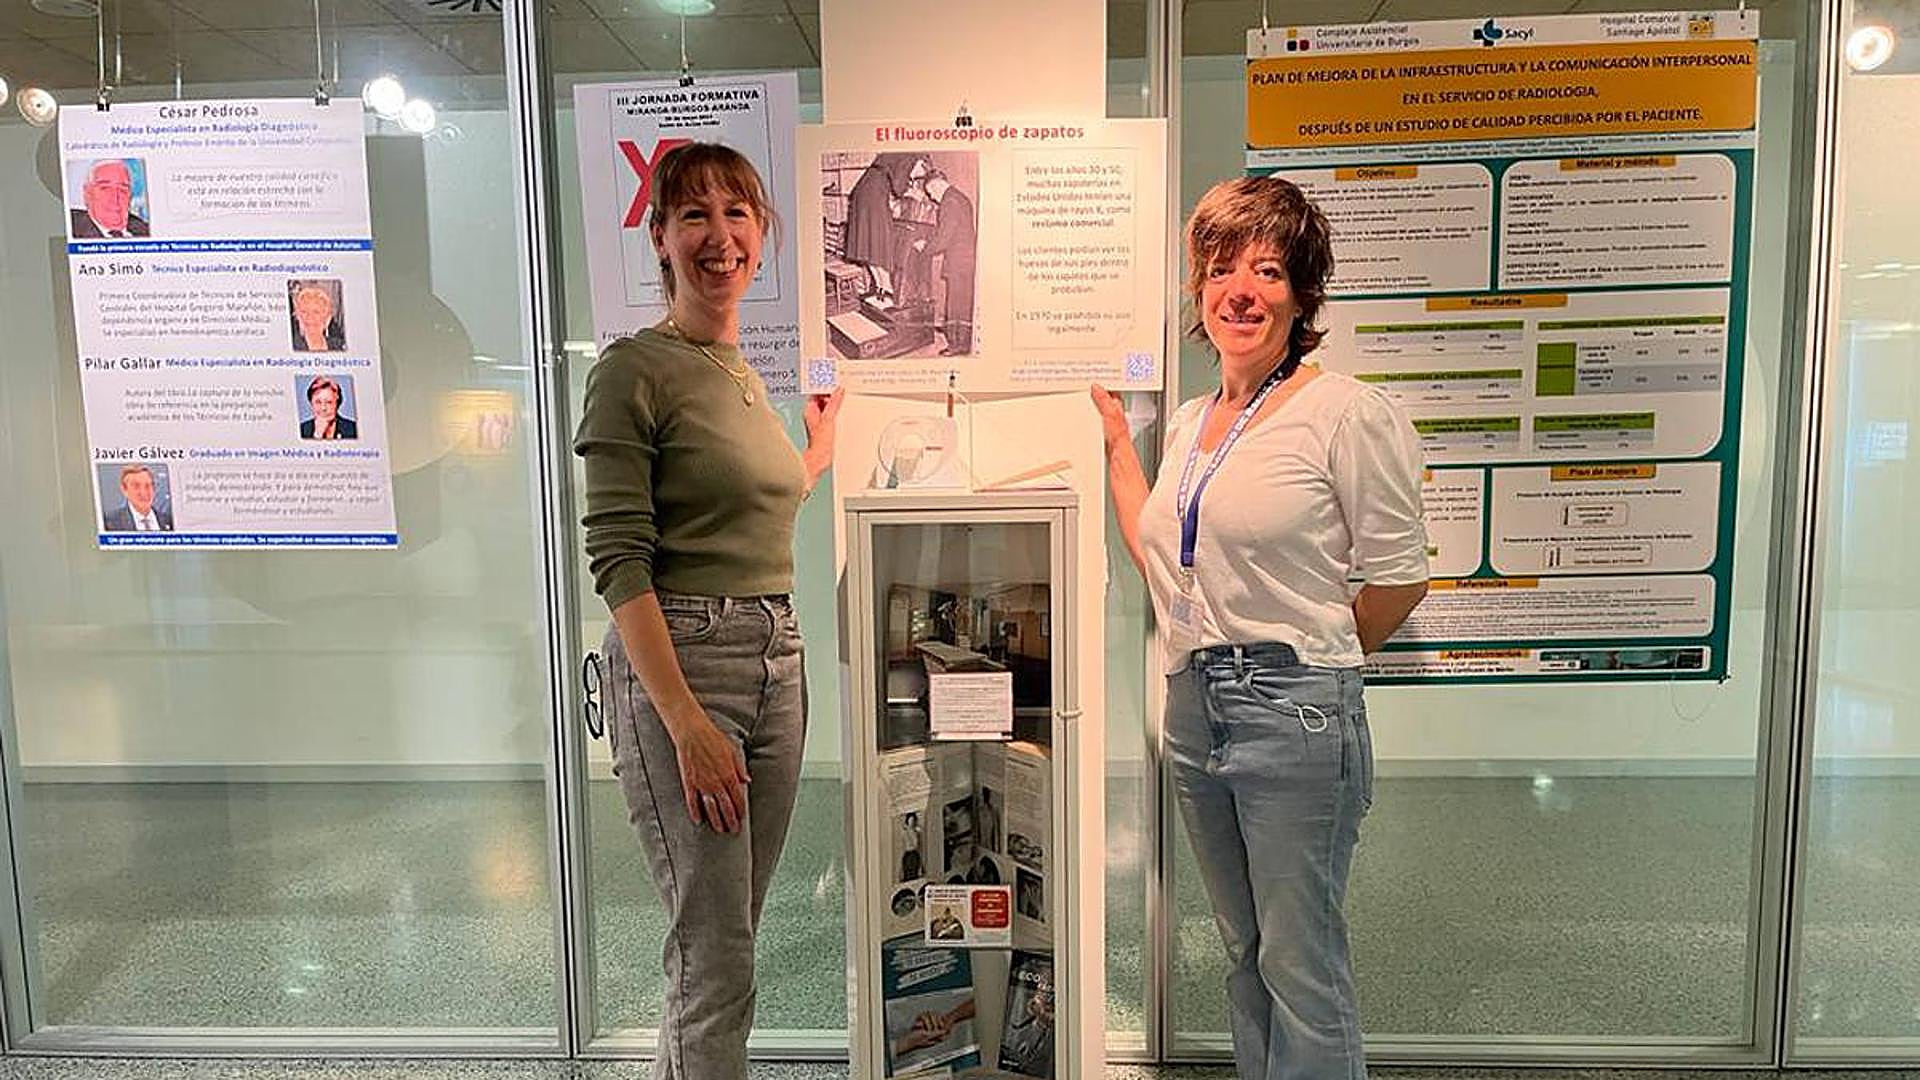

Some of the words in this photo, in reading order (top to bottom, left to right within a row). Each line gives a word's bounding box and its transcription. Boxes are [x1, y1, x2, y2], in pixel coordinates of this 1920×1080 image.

[1252, 72, 1285, 85] PLAN
[1288, 72, 1302, 83] DE
[1307, 69, 1358, 82] MEJORA
[1361, 68, 1377, 79] DE
[1380, 68, 1396, 79] LA
[1399, 63, 1518, 78] INFRAESTRUCTURA
[1519, 62, 1528, 73] Y
[1530, 61, 1546, 72] LA
[1547, 55, 1650, 71] COMUNICACIÓN
[1653, 54, 1752, 68] INTERPERSONAL
[616, 97, 629, 106] III
[632, 93, 688, 105] JORNADA
[691, 90, 759, 102] FORMATIVA
[1403, 93, 1419, 105] EN
[1422, 93, 1436, 104] EL
[1438, 90, 1494, 103] SERVICIO
[1498, 89, 1515, 101] DE
[159, 105, 198, 120] César
[202, 103, 259, 118] Pedrosa
[1299, 121, 1353, 136] DESPUÉS
[1355, 122, 1371, 134] DE
[1374, 120, 1393, 132] UN
[1396, 118, 1453, 131] ESTUDIO
[1454, 117, 1470, 129] DE
[1471, 115, 1525, 128] CALIDAD
[1528, 113, 1593, 126] PERCIBIDA
[1596, 112, 1622, 124] POR
[1625, 111, 1640, 122] EL
[1641, 108, 1704, 121] PACIENTE.
[147, 124, 197, 136] Especialista
[199, 125, 211, 133] en
[876, 127, 890, 142] El
[894, 125, 994, 143] fluoroscopio
[998, 125, 1018, 140] de
[1023, 126, 1085, 143] zapatos
[1576, 159, 1613, 169] Material
[1614, 160, 1622, 170] y
[79, 262, 105, 276] Ana
[186, 263, 237, 274] Especialista
[239, 264, 250, 272] en
[1470, 298, 1522, 307] Resultados
[86, 358, 117, 371] Pilar
[120, 356, 162, 370] Gallar
[201, 357, 251, 368] Especialista
[253, 358, 265, 366] en
[95, 447, 134, 464] Javier
[138, 446, 185, 463] Gálvez
[1569, 468, 1590, 477] Plan
[1593, 467, 1606, 476] de
[1456, 579, 1509, 589] Referencias
